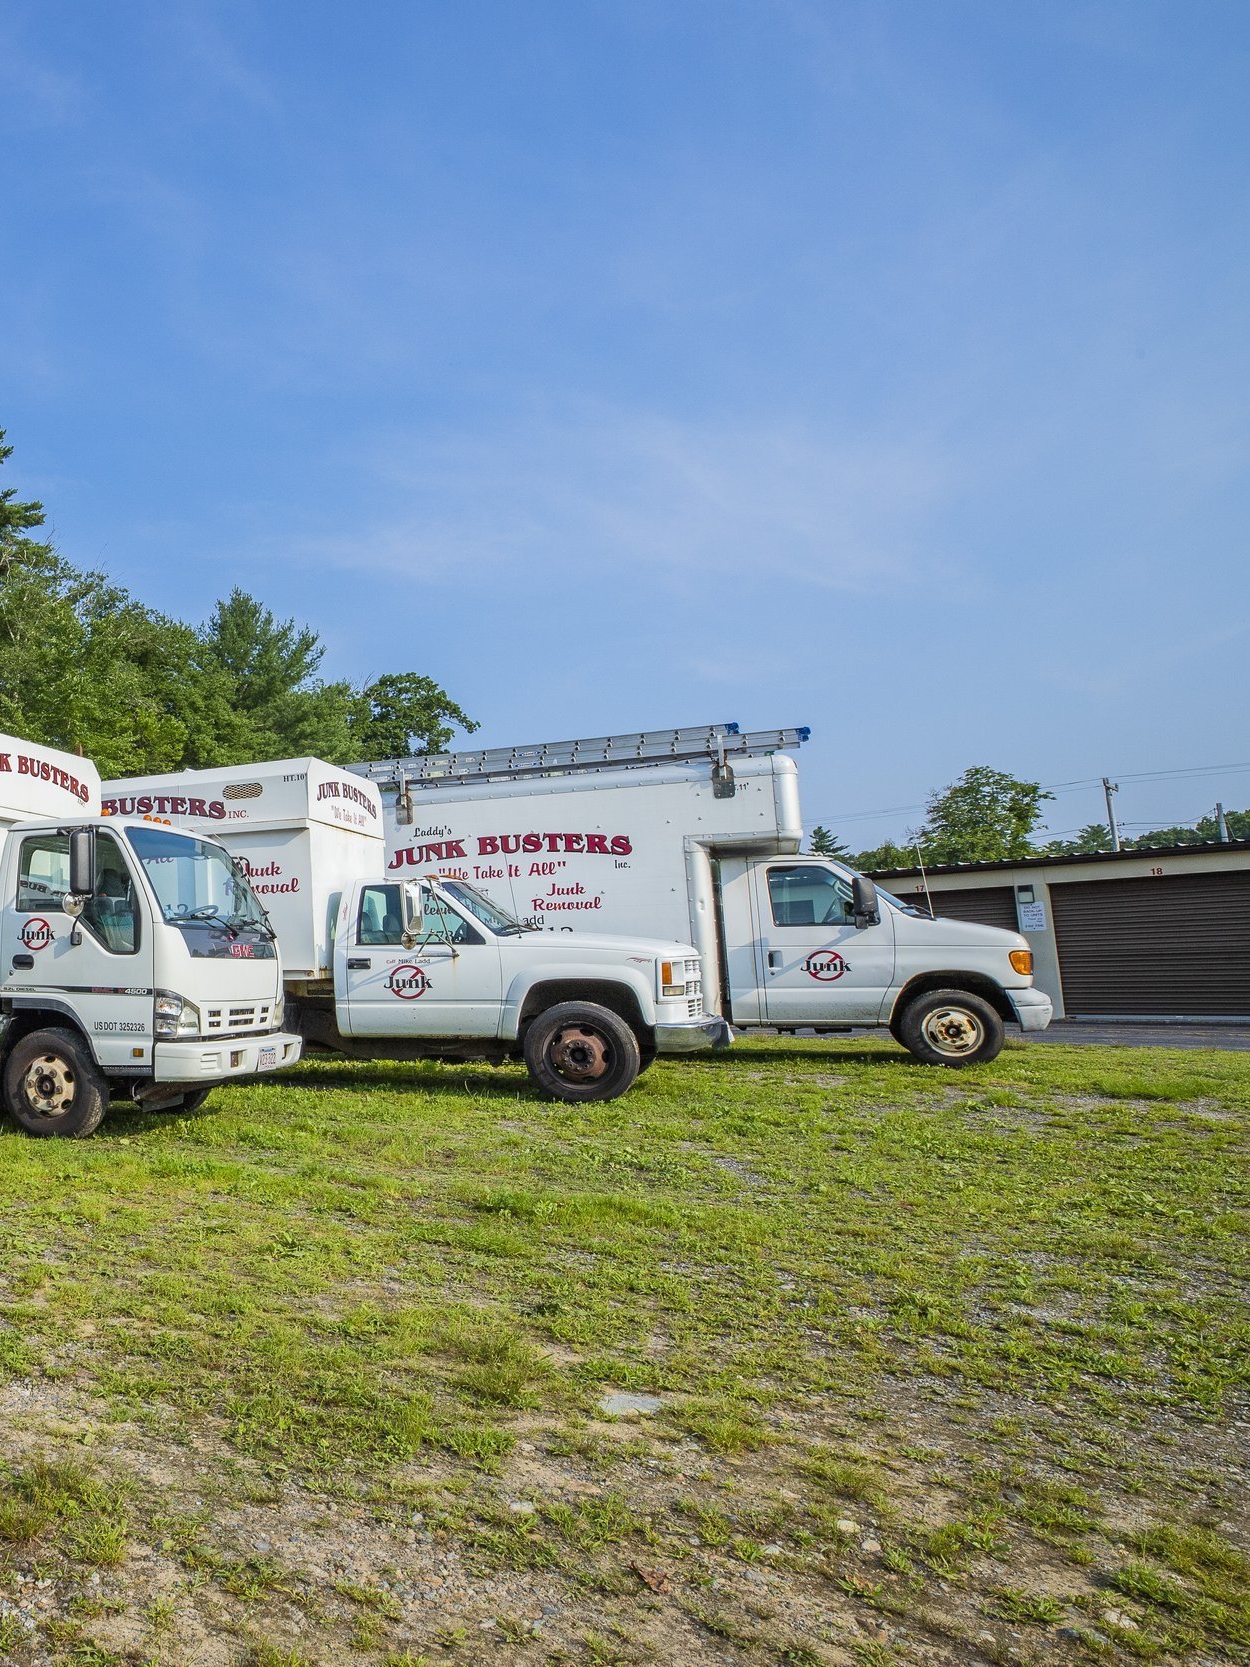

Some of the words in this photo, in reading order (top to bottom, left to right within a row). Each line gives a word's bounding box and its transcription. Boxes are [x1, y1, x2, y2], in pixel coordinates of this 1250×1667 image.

[17, 754, 90, 803] BUSTERS
[317, 782, 340, 801] JUNK
[342, 782, 377, 820] BUSTERS
[100, 796, 227, 820] BUSTERS
[228, 810, 249, 819] INC.
[413, 825, 452, 838] Laddy's
[387, 838, 468, 870] JUNK
[477, 832, 633, 857] BUSTERS
[614, 859, 631, 870] Inc.
[1150, 867, 1163, 875] 18
[473, 865, 504, 880] Take
[508, 864, 521, 878] It
[546, 882, 587, 897] Junk
[531, 896, 603, 912] Removal
[522, 914, 545, 925] add
[17, 929, 55, 940] Junk
[801, 960, 852, 971] Junk
[384, 976, 433, 988] Junk
[119, 1022, 145, 1032] 3252326
